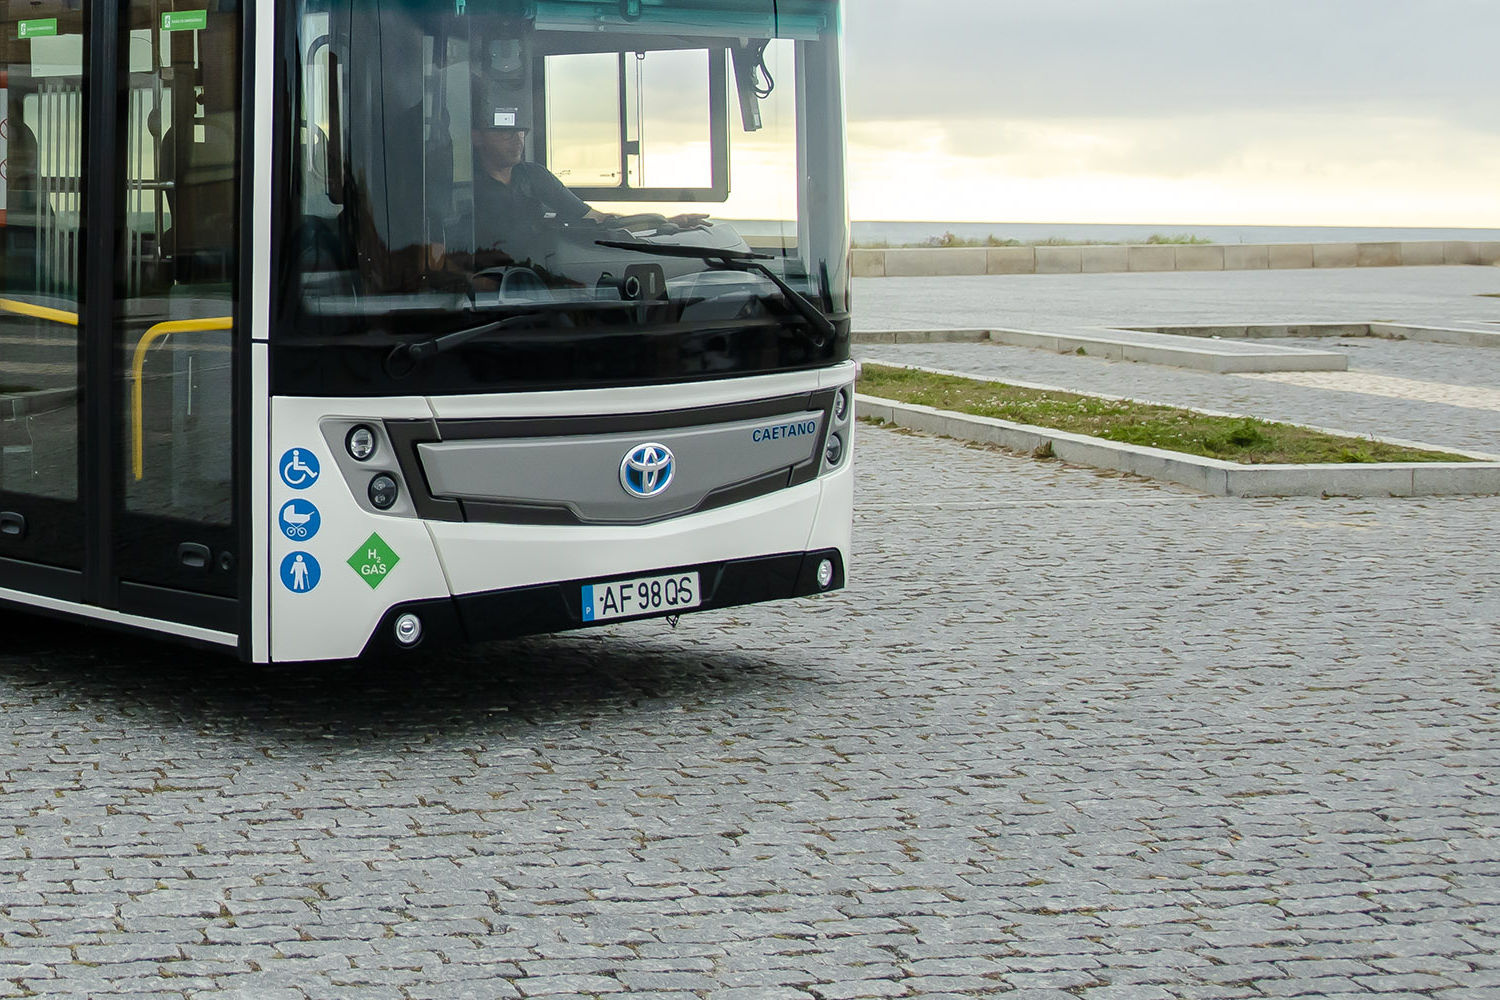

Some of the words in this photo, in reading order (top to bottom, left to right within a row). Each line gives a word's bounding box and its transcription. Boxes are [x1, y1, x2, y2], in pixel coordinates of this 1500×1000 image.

[752, 420, 816, 443] CAETANO
[360, 563, 387, 575] GAS
[585, 606, 592, 615] P
[602, 583, 634, 616] AF
[638, 580, 662, 610] 98
[664, 576, 693, 605] QS
